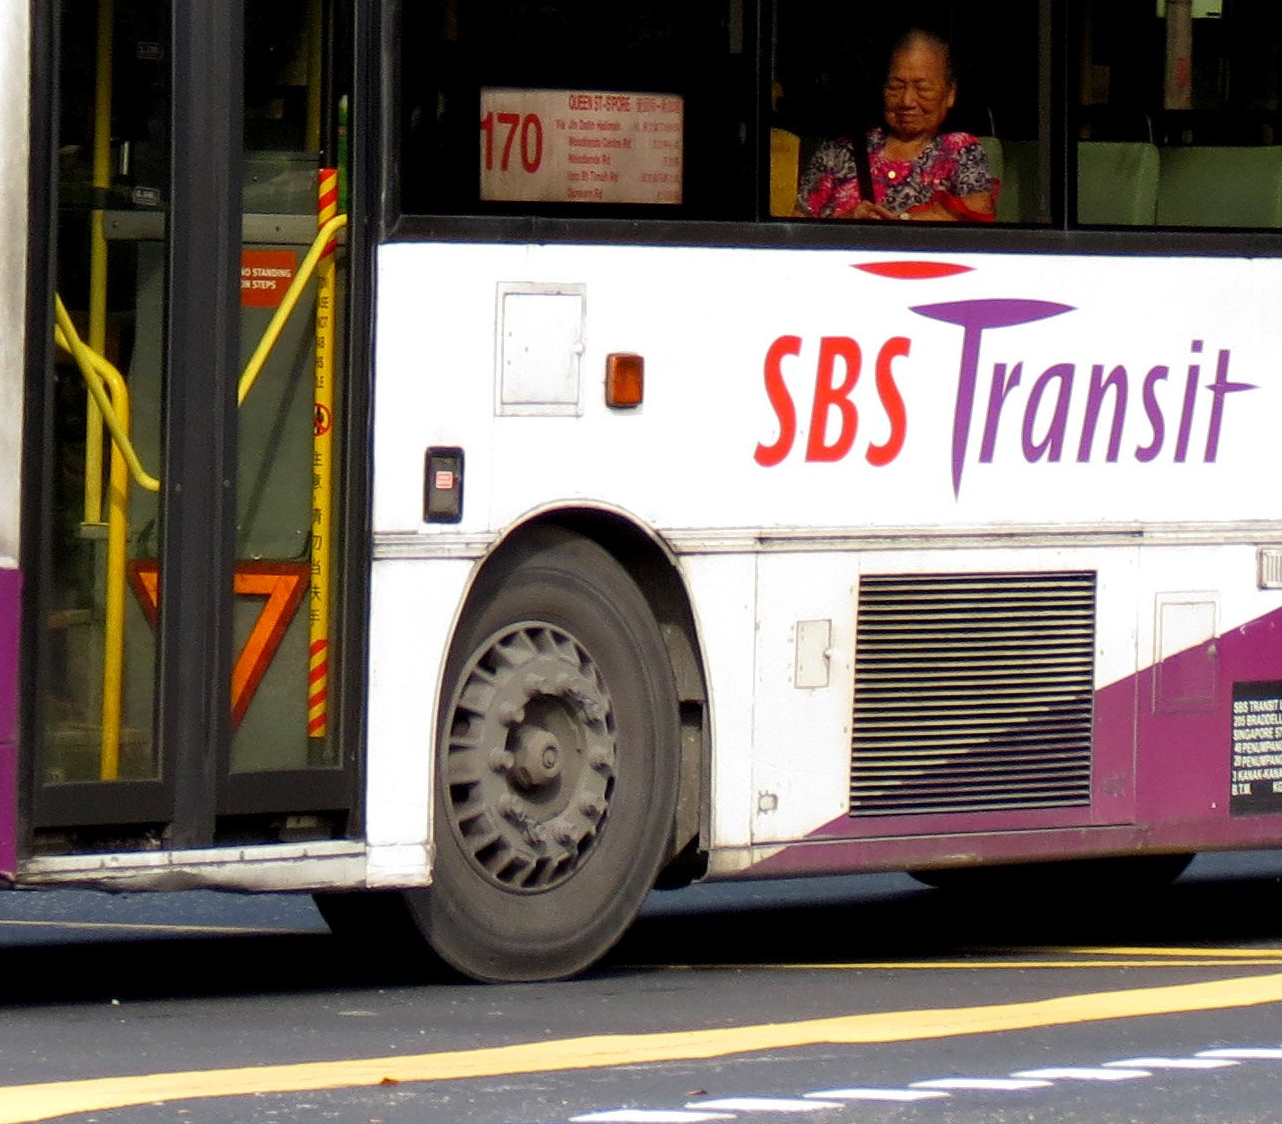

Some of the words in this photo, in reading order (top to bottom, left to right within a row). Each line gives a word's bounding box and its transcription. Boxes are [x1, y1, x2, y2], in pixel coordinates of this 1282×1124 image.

[480, 111, 544, 174] 170
[252, 268, 292, 278] STANDING
[252, 280, 277, 290] STEPS
[752, 334, 912, 468] SBS
[907, 297, 1261, 504] Transit
